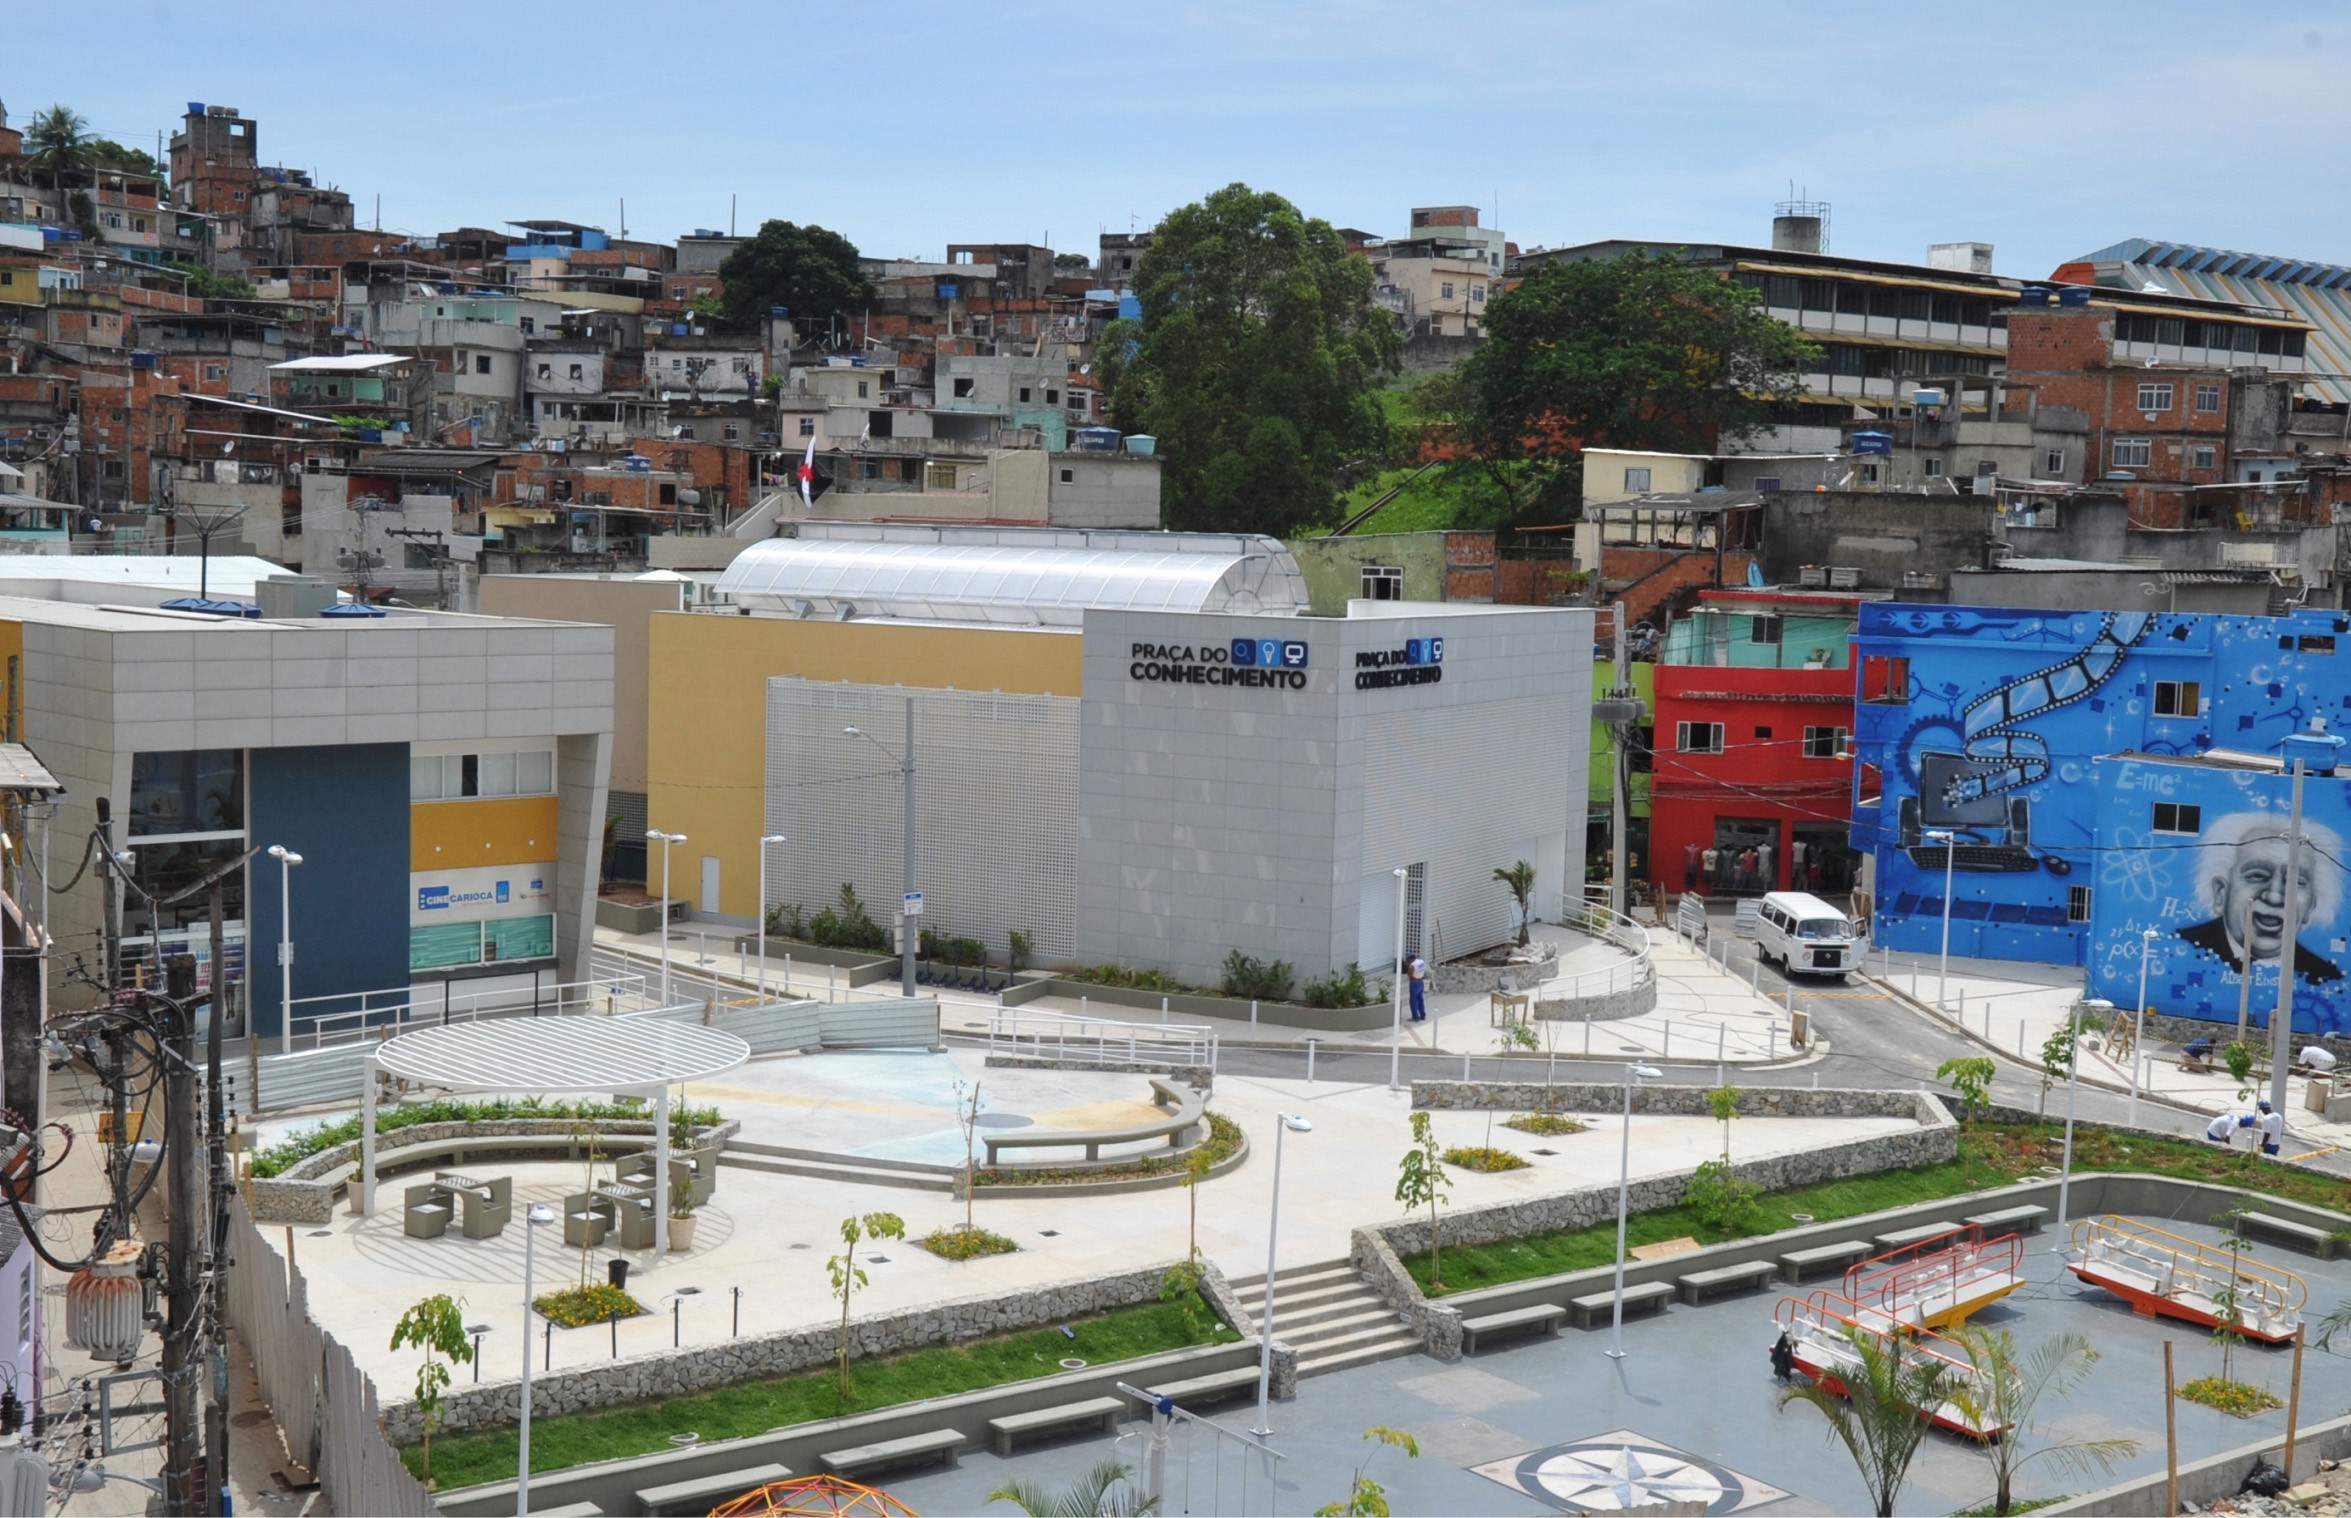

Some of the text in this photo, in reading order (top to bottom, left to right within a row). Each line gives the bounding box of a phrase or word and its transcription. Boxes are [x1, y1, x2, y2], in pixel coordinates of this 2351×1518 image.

[1132, 643, 1228, 663] PRAÇA DO
[1356, 650, 1406, 668] PRAÇA DO
[1130, 662, 1307, 690] CONHECIMENTO
[1355, 666, 1442, 690] CONHECIMENTO
